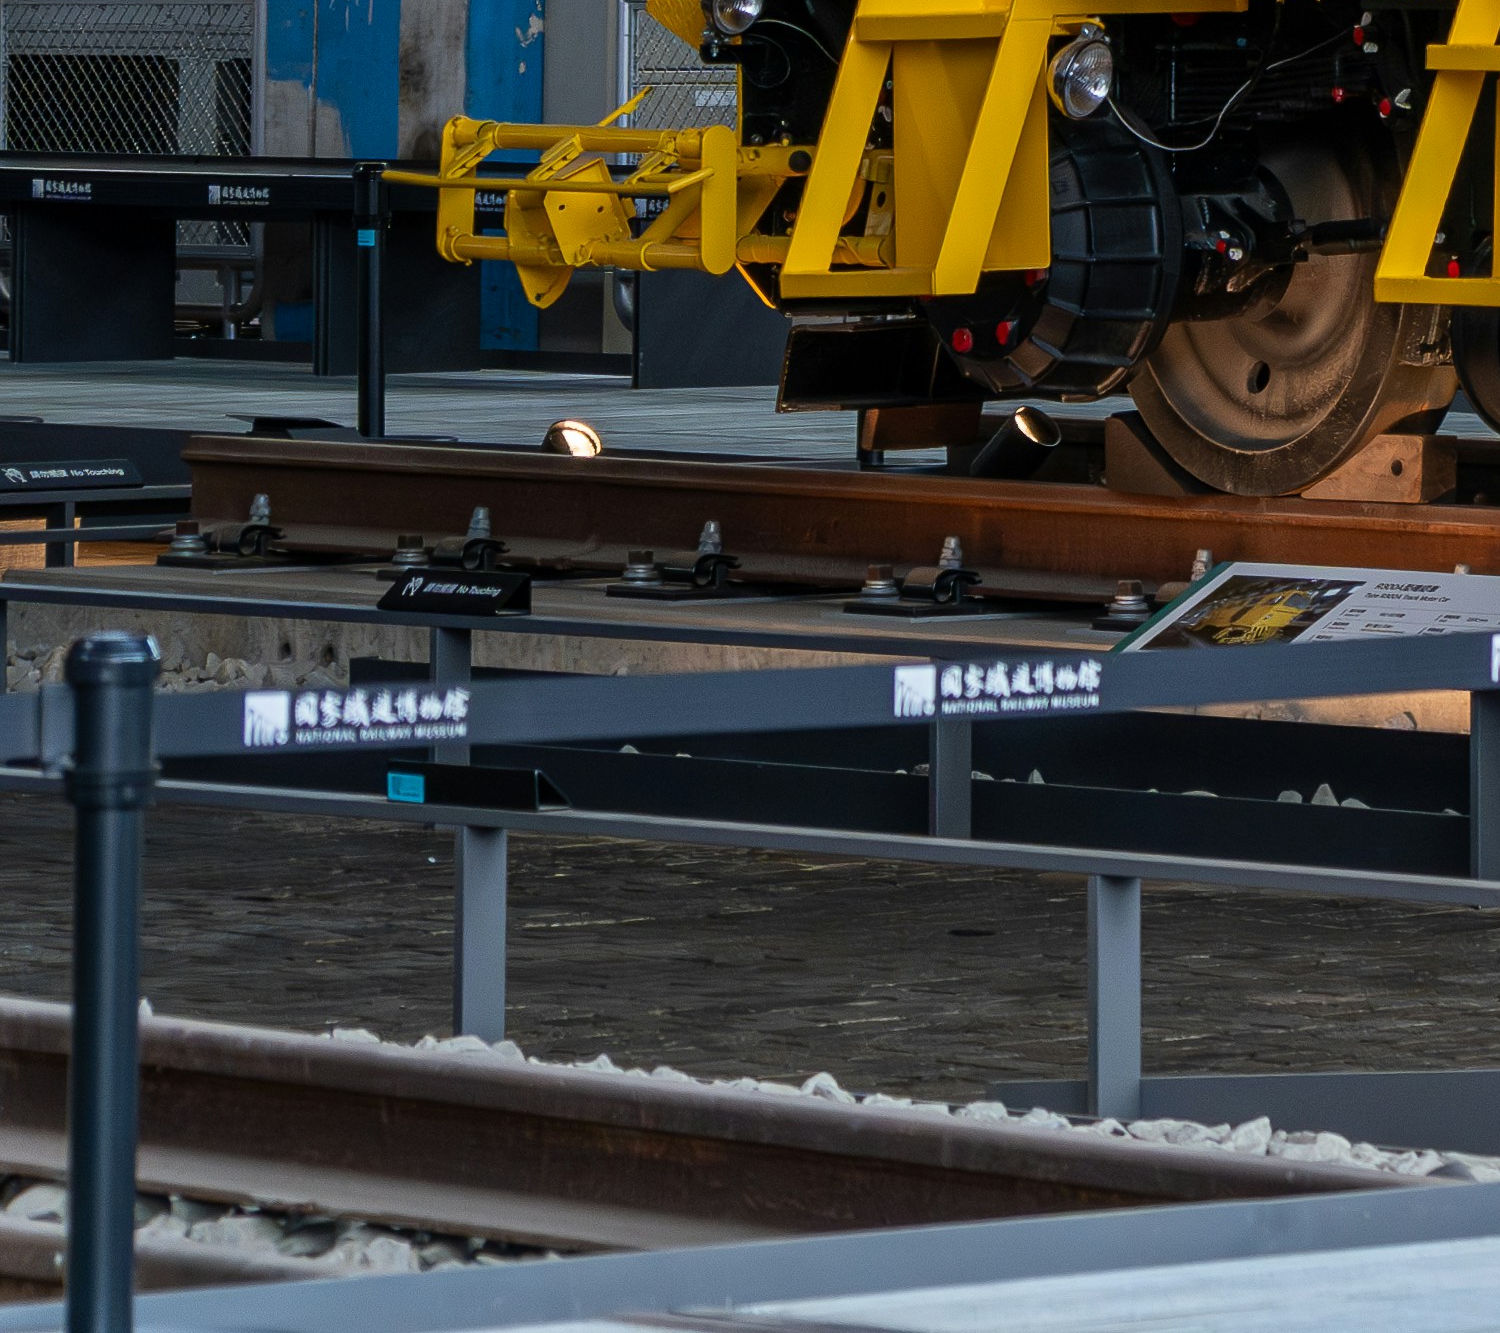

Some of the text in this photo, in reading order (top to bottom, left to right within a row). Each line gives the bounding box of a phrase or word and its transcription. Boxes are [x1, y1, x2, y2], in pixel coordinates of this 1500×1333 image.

[70, 469, 83, 477] No
[83, 467, 125, 476] Touching
[941, 659, 1102, 698] 國家鐵道博物館
[295, 686, 470, 727] 國家鐵道博物館
[296, 723, 467, 744] NATIONAL RAILWAY MUSEUM
